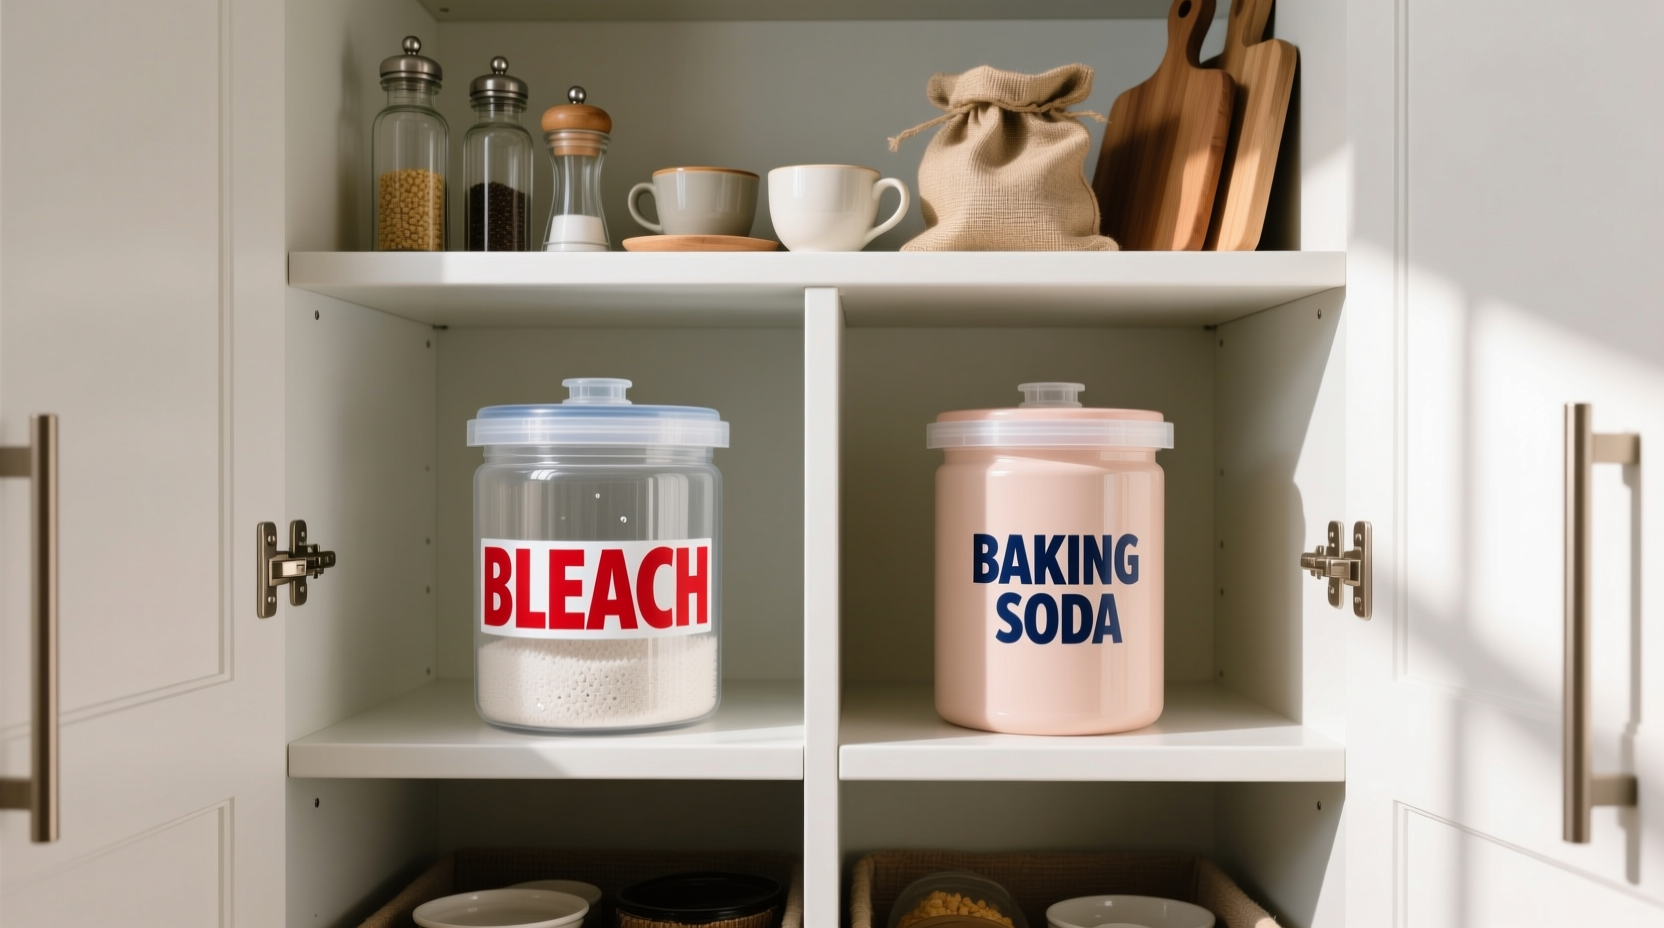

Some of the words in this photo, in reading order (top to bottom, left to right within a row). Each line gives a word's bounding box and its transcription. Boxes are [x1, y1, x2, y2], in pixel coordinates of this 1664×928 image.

[973, 533, 1139, 585] BAKING
[484, 545, 709, 630] BLEACH
[995, 592, 1123, 645] SODA
